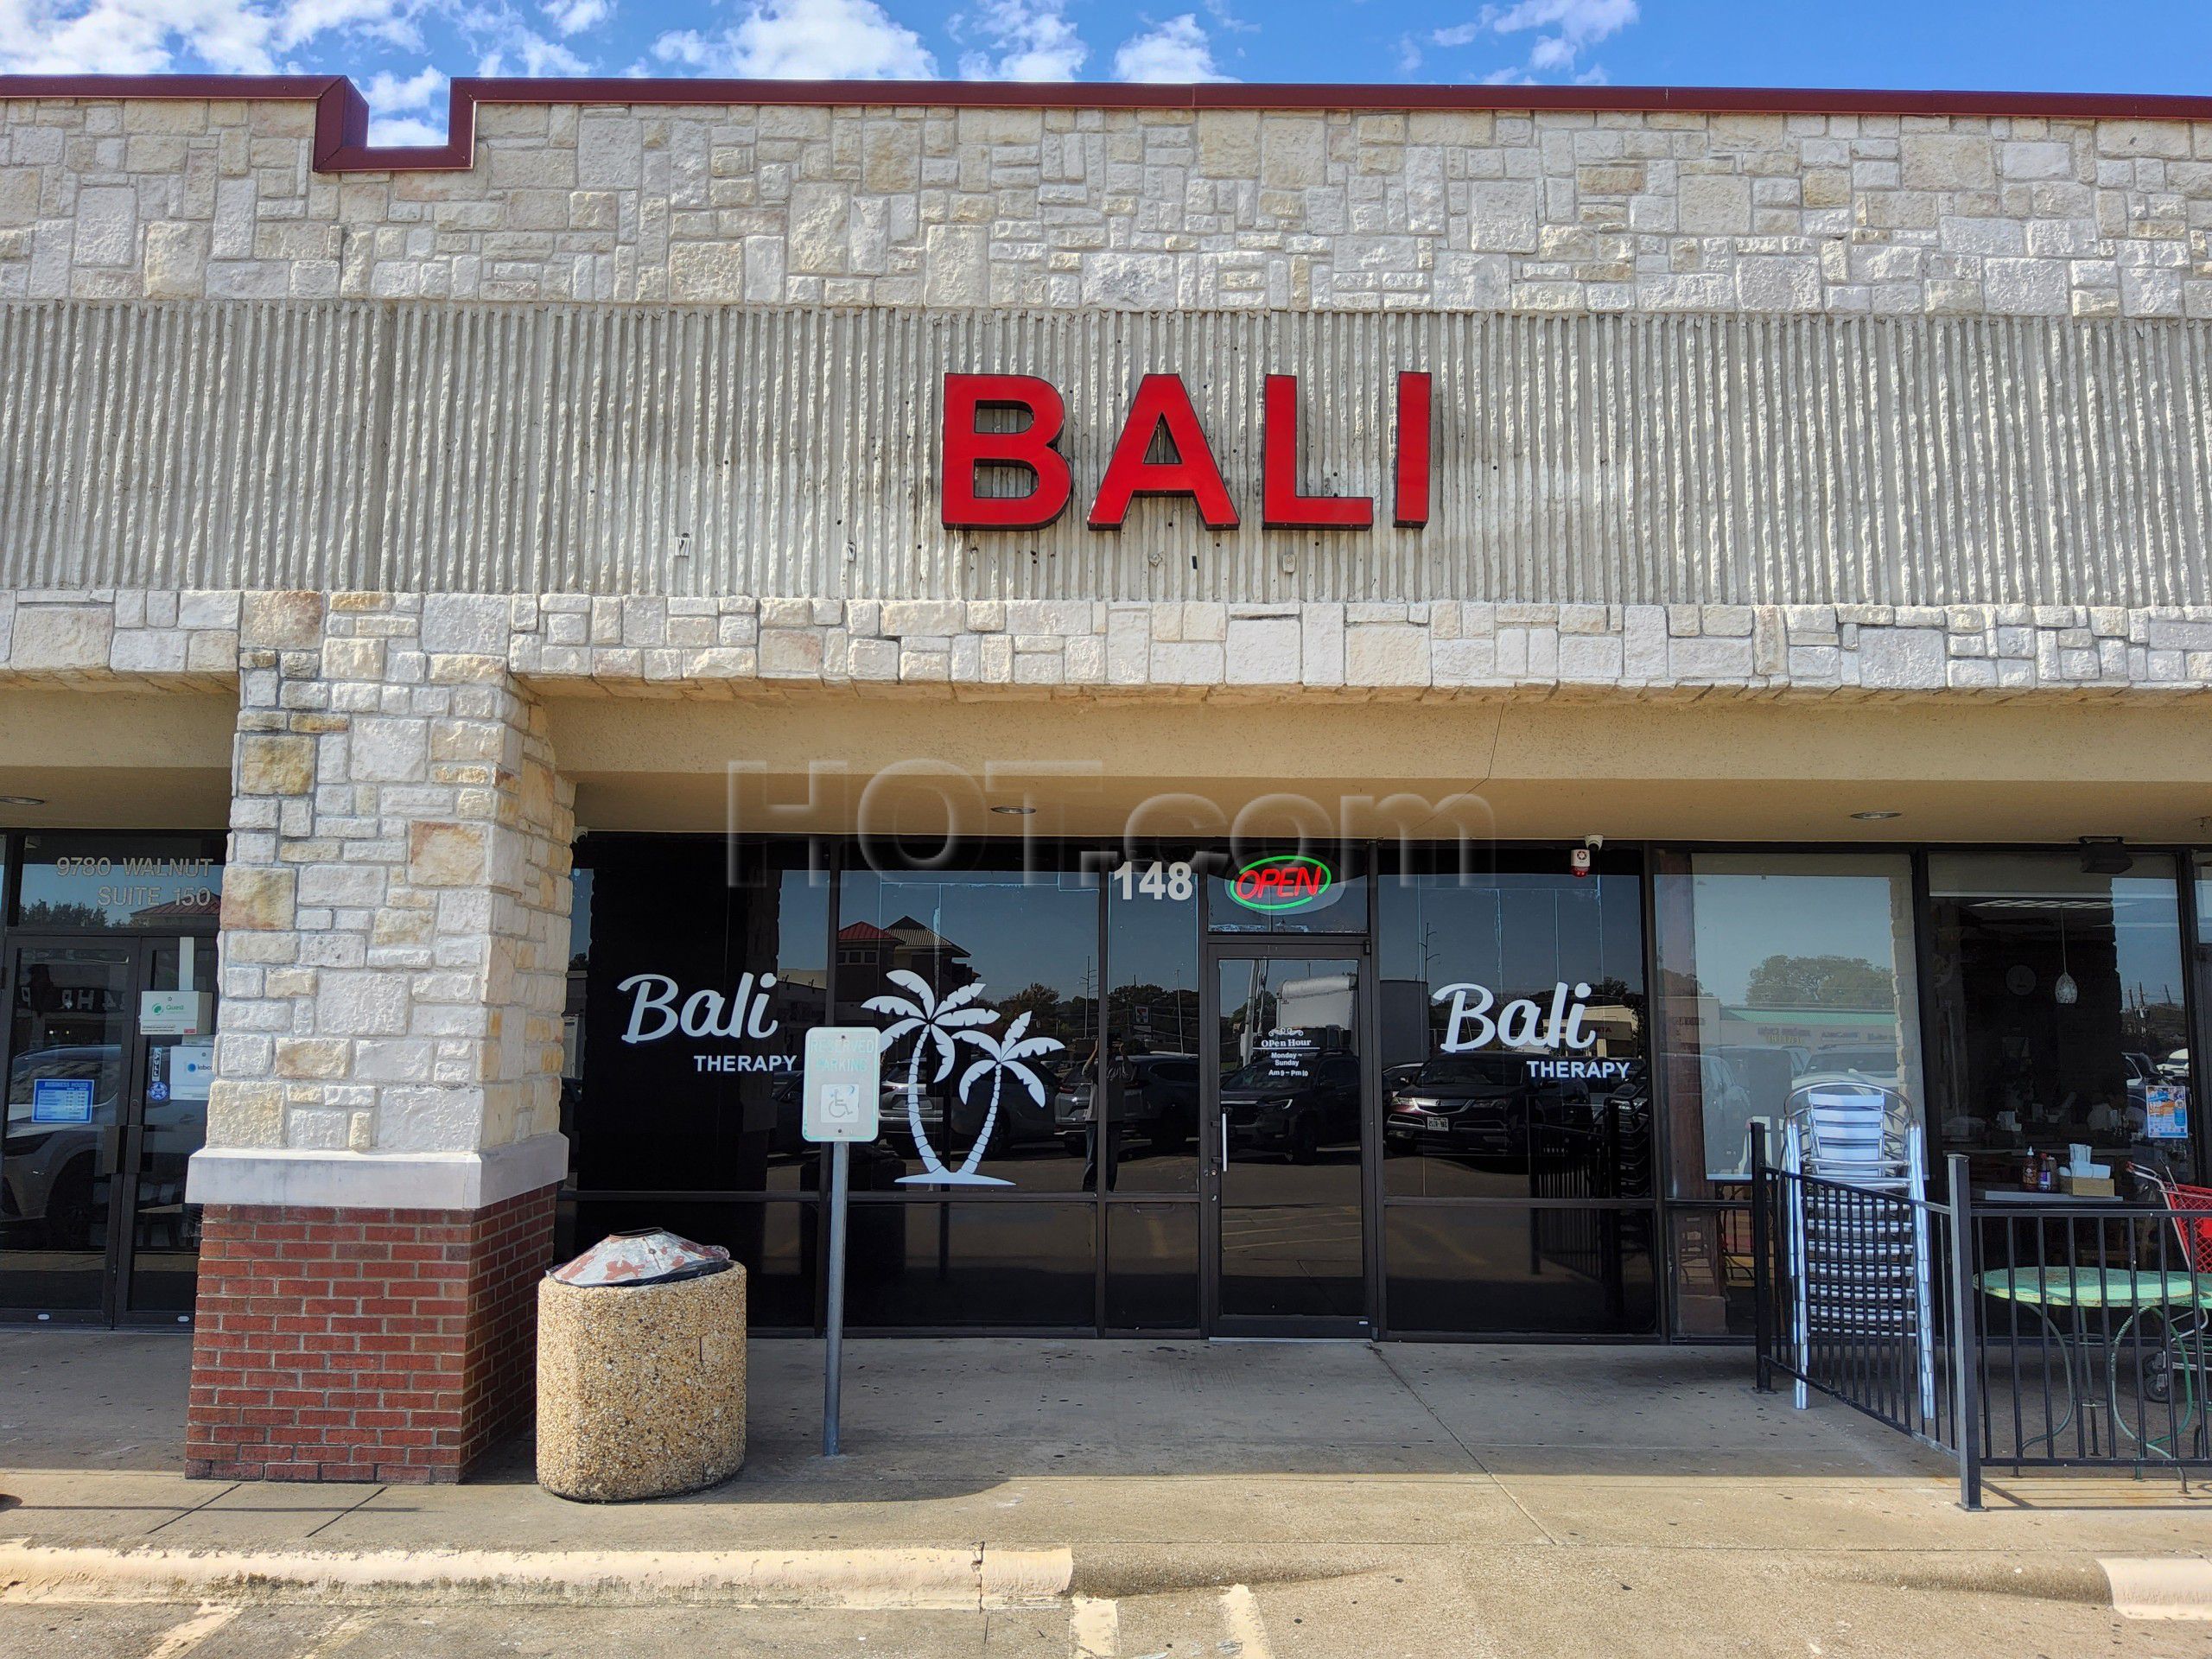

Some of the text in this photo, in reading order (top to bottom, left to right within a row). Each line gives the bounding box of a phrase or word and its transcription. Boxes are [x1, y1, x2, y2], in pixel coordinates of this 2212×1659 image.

[942, 372, 1432, 531] BALI
[56, 856, 214, 877] 9780 WALNUT
[1113, 861, 1193, 900] 148
[1236, 866, 1321, 899] OPEN
[97, 886, 211, 906] SUITE 150
[617, 972, 778, 1044] Bali
[1432, 982, 1597, 1053] Bali
[810, 1039, 874, 1053] RESERVED
[694, 1055, 798, 1071] THERAPY
[816, 1057, 868, 1072] PARKING
[1526, 1060, 1630, 1079] THERAPY
